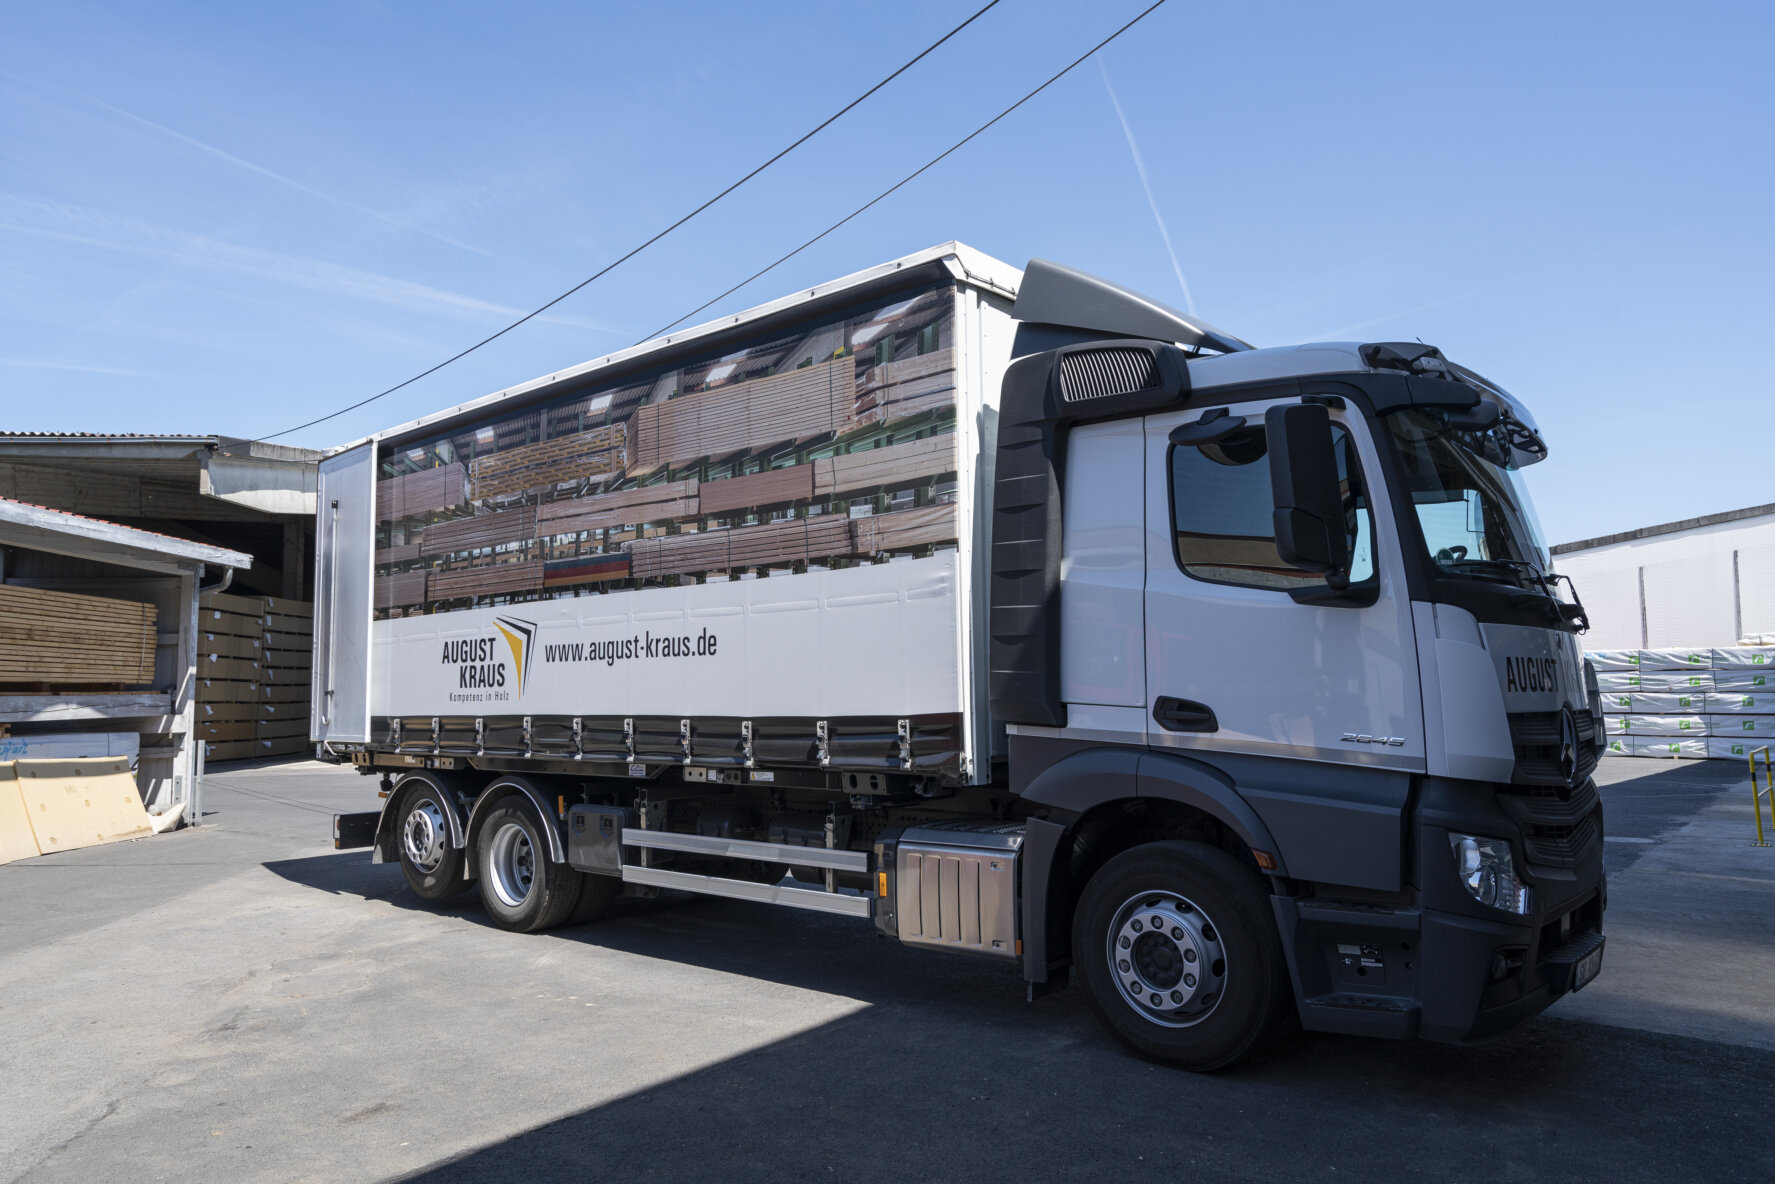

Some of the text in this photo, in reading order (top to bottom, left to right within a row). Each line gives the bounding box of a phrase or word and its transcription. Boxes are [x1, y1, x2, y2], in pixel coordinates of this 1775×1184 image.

[442, 638, 496, 664] AUGUST
[545, 627, 716, 666] www.august-kraus.de
[459, 662, 505, 689] KRAUS
[1506, 656, 1558, 693] AUGUST
[449, 690, 509, 704] Kompetenz in Holz
